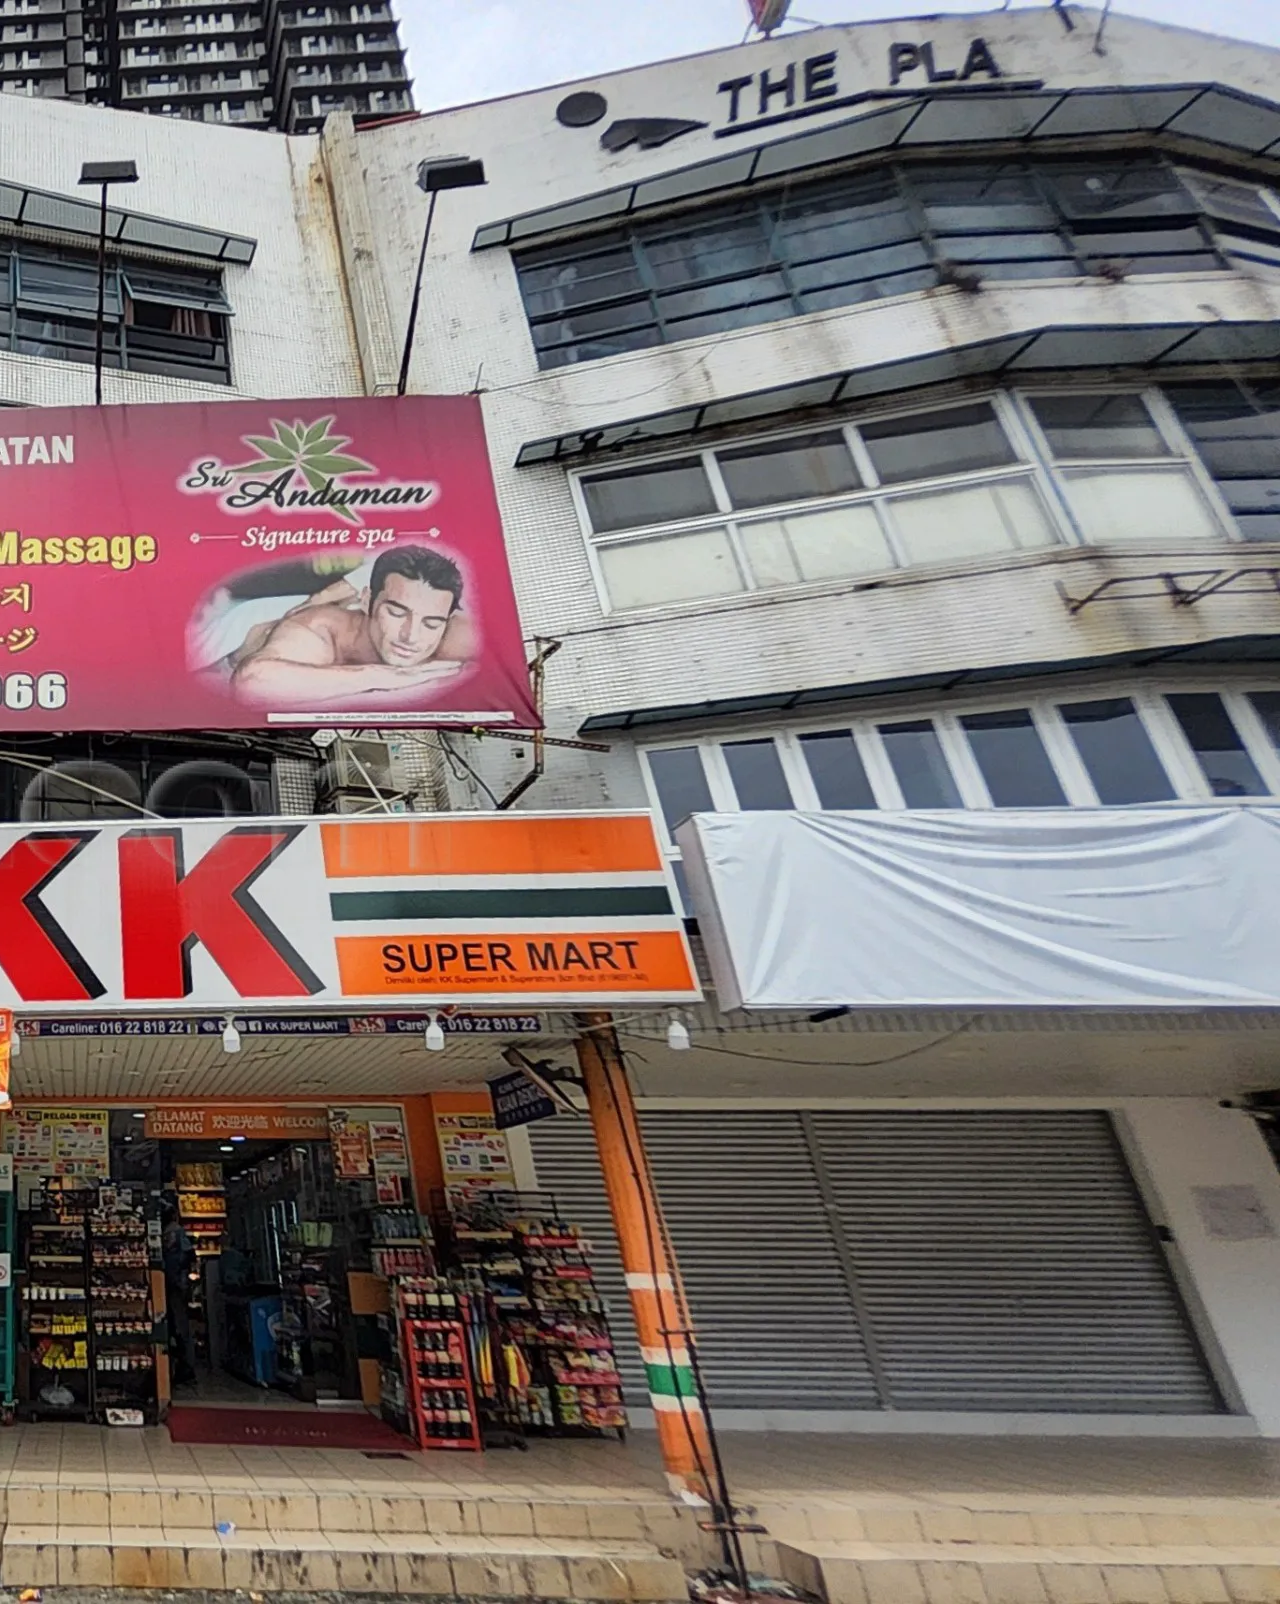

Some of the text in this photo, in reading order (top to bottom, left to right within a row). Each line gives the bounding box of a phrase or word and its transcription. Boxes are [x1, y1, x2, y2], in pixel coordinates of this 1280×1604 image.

[717, 50, 838, 122] THE
[226, 468, 432, 510] Andaman
[241, 526, 396, 551] Signature spa
[382, 940, 640, 973] SUPER MART
[51, 1023, 98, 1034] Careline:
[100, 1022, 122, 1034] 016
[125, 1022, 141, 1034] 22
[143, 1022, 166, 1033] 818
[169, 1021, 184, 1033] 22
[265, 1022, 279, 1031] KK
[280, 1021, 311, 1031] SUPER
[313, 1021, 339, 1030] MART
[448, 1018, 471, 1031] 016
[475, 1018, 492, 1031] 22
[494, 1018, 518, 1031] 818
[521, 1017, 537, 1030] 22
[43, 1112, 77, 1121] RELOAD
[149, 1110, 205, 1122] SELAMAT
[273, 1116, 328, 1128] WELCOM
[153, 1122, 203, 1134] DATANG
